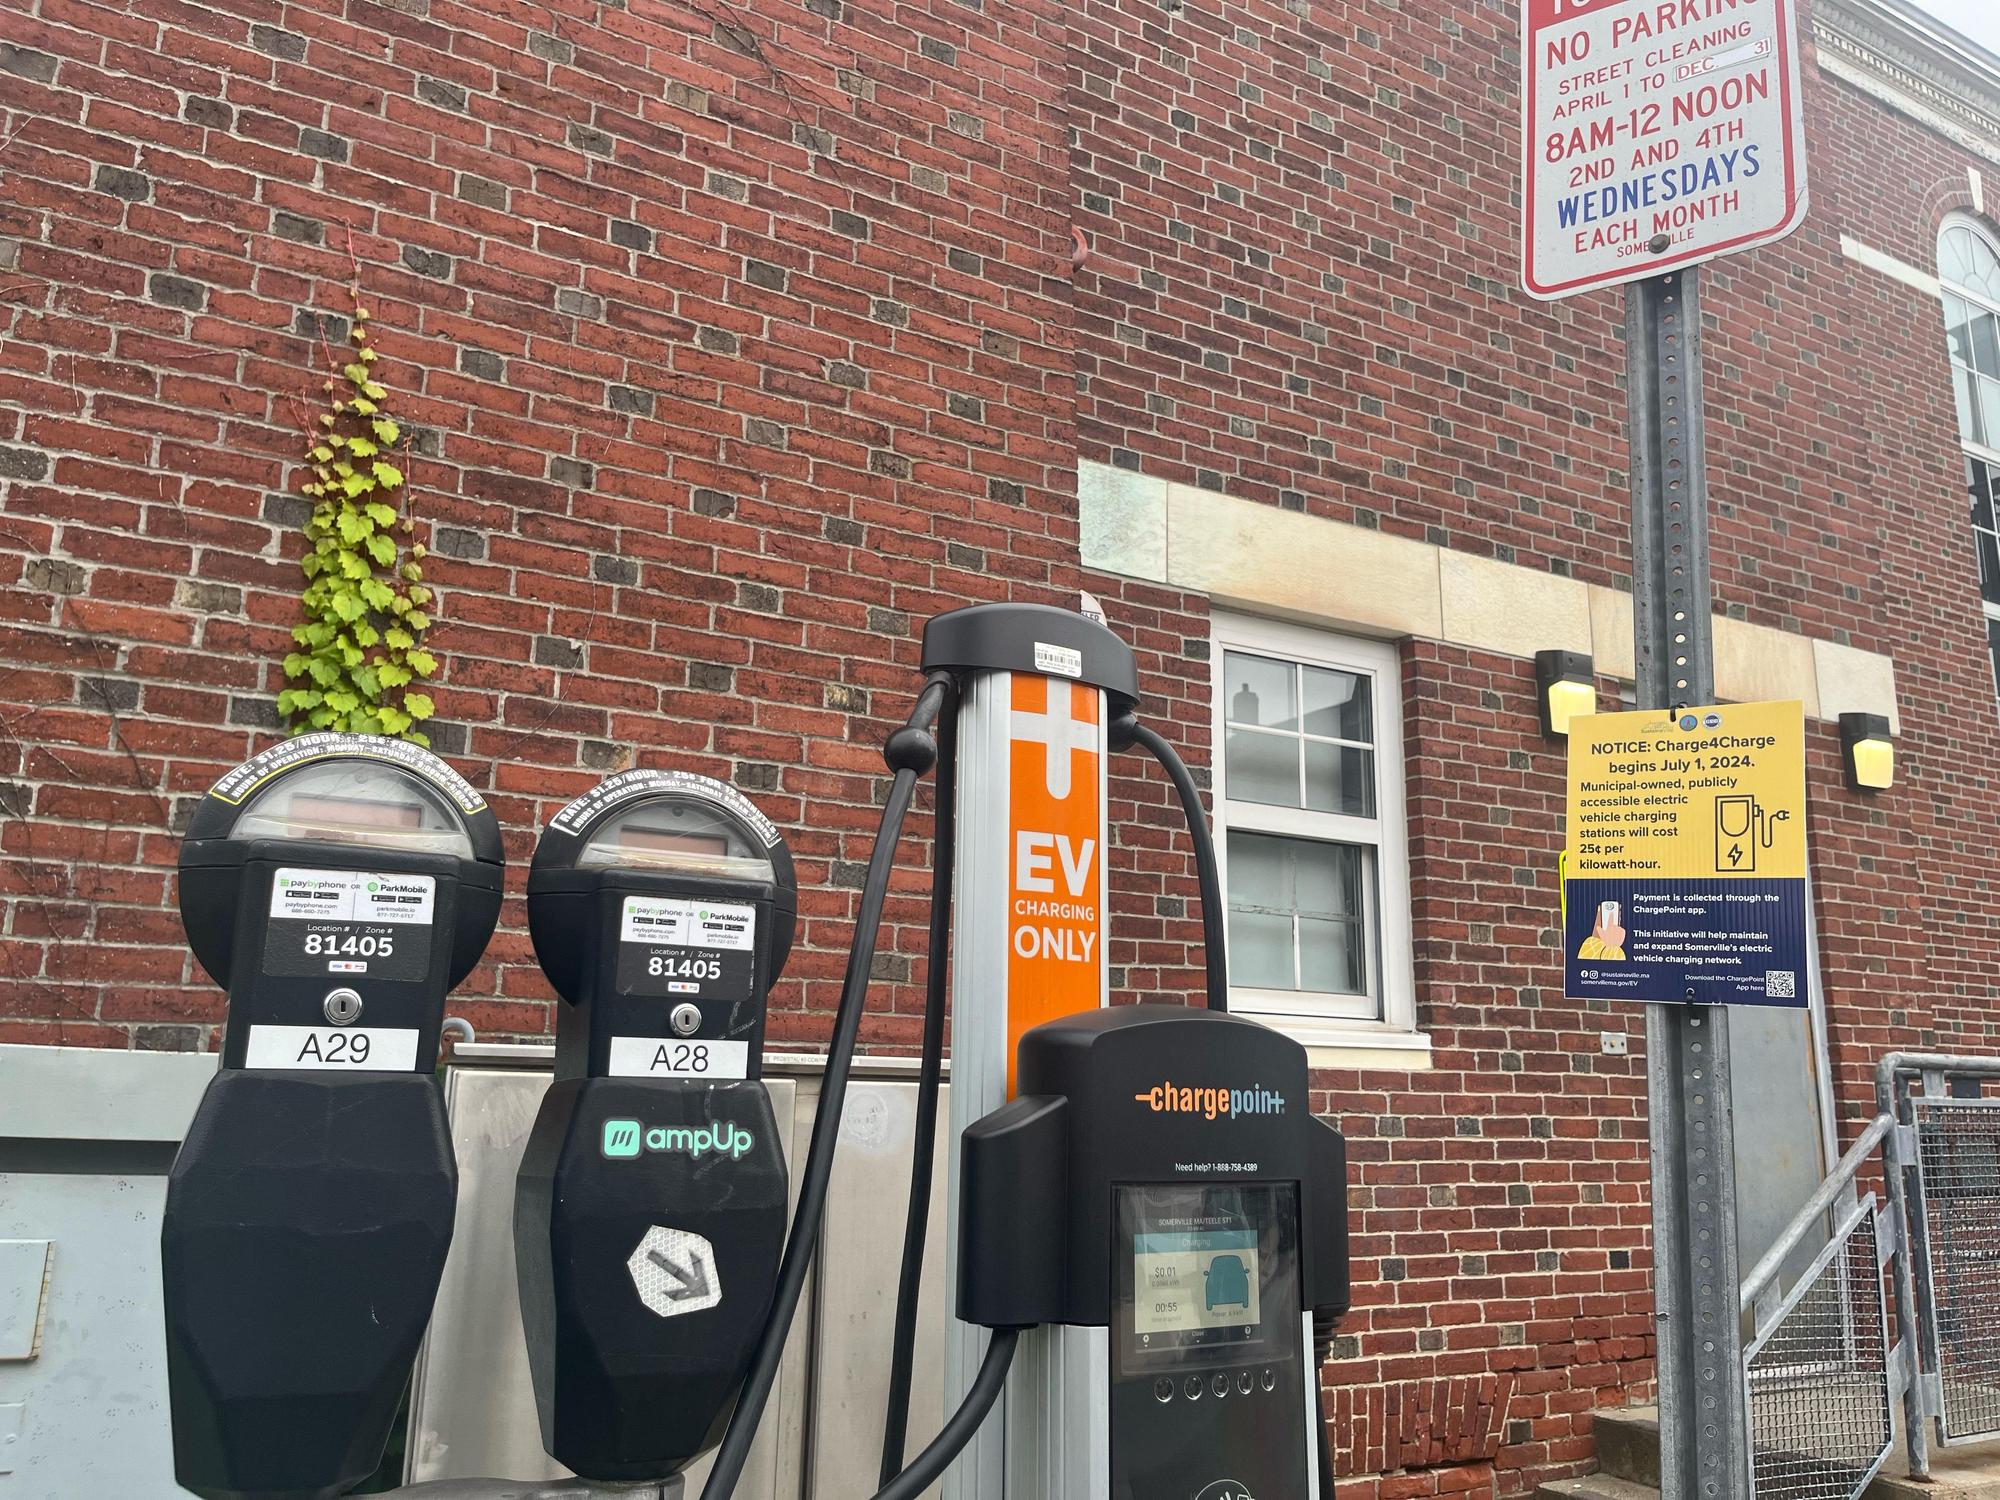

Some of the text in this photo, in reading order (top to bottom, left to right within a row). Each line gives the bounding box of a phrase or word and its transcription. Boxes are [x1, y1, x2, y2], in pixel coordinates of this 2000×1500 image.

[1547, 0, 1757, 69] NO PARKIN
[1559, 20, 1751, 95] STREET CLEANING
[1552, 91, 1612, 121] APRIL
[1623, 84, 1629, 98] 1
[1640, 73, 1665, 93] TO
[1754, 40, 1769, 55] 31
[1546, 69, 1768, 163] 8AM-12 NOON
[1569, 118, 1743, 188] 2ND AND 4TH
[1558, 144, 1760, 229] WEDNESDAYS
[1575, 190, 1739, 253] EACH MONTH
[1617, 228, 1695, 258] SOMEILLE
[1591, 735, 1776, 755] NOTICE: Charge4Charge
[231, 776, 258, 798] HOURS
[259, 766, 270, 777] OF
[270, 747, 324, 769] OPERATION:
[1609, 755, 1755, 775] begins July 1, 2024.
[217, 764, 255, 793] RATE:
[1581, 776, 1738, 793] Municipal-owned, publicly
[572, 807, 595, 829] HOURS
[593, 799, 604, 810] OF
[603, 782, 647, 803] OPERATION:
[1580, 794, 1689, 807] accessible electric
[559, 797, 591, 823] RATE:
[1580, 810, 1677, 825] vehicle charging
[1580, 827, 1678, 838] stations will cost
[1579, 844, 1624, 857] 25¢ per
[1016, 830, 1096, 896] EV
[1579, 858, 1661, 870] kilowatt-hour.
[291, 880, 346, 889] paybyphone
[380, 884, 427, 893] ParkMobile
[1633, 893, 1779, 904] Payment is collected through the
[637, 907, 682, 917] paybyphone
[710, 912, 749, 922] ParkMobile
[1015, 899, 1094, 921] CHARGING
[1633, 905, 1707, 916] ChargePoint app.
[307, 923, 342, 932] Location
[355, 926, 359, 934] /
[365, 926, 385, 934] Zone
[1633, 930, 1768, 941] This initiative will help maintain
[304, 933, 394, 957] 81405
[650, 948, 679, 956] Location
[1014, 925, 1096, 963] ONLY
[1633, 942, 1773, 953] and expand Somerville's electric
[648, 956, 721, 979] 81405
[1633, 954, 1664, 963] vehicle
[1665, 955, 1703, 965] charging
[1685, 974, 1714, 982] Download
[1726, 975, 1765, 983] ChargePoint
[1736, 984, 1749, 993] App
[297, 1033, 371, 1064] A29
[650, 1044, 709, 1073] A28
[1135, 1080, 1285, 1120] chargepoint
[646, 1123, 752, 1158] ampUp
[1175, 1163, 1193, 1171] Need
[1194, 1163, 1211, 1172] help?
[1158, 1218, 1193, 1226] SOMERVILLE
[1154, 1266, 1176, 1278] $0.01
[1155, 1302, 1178, 1313] 00:55
